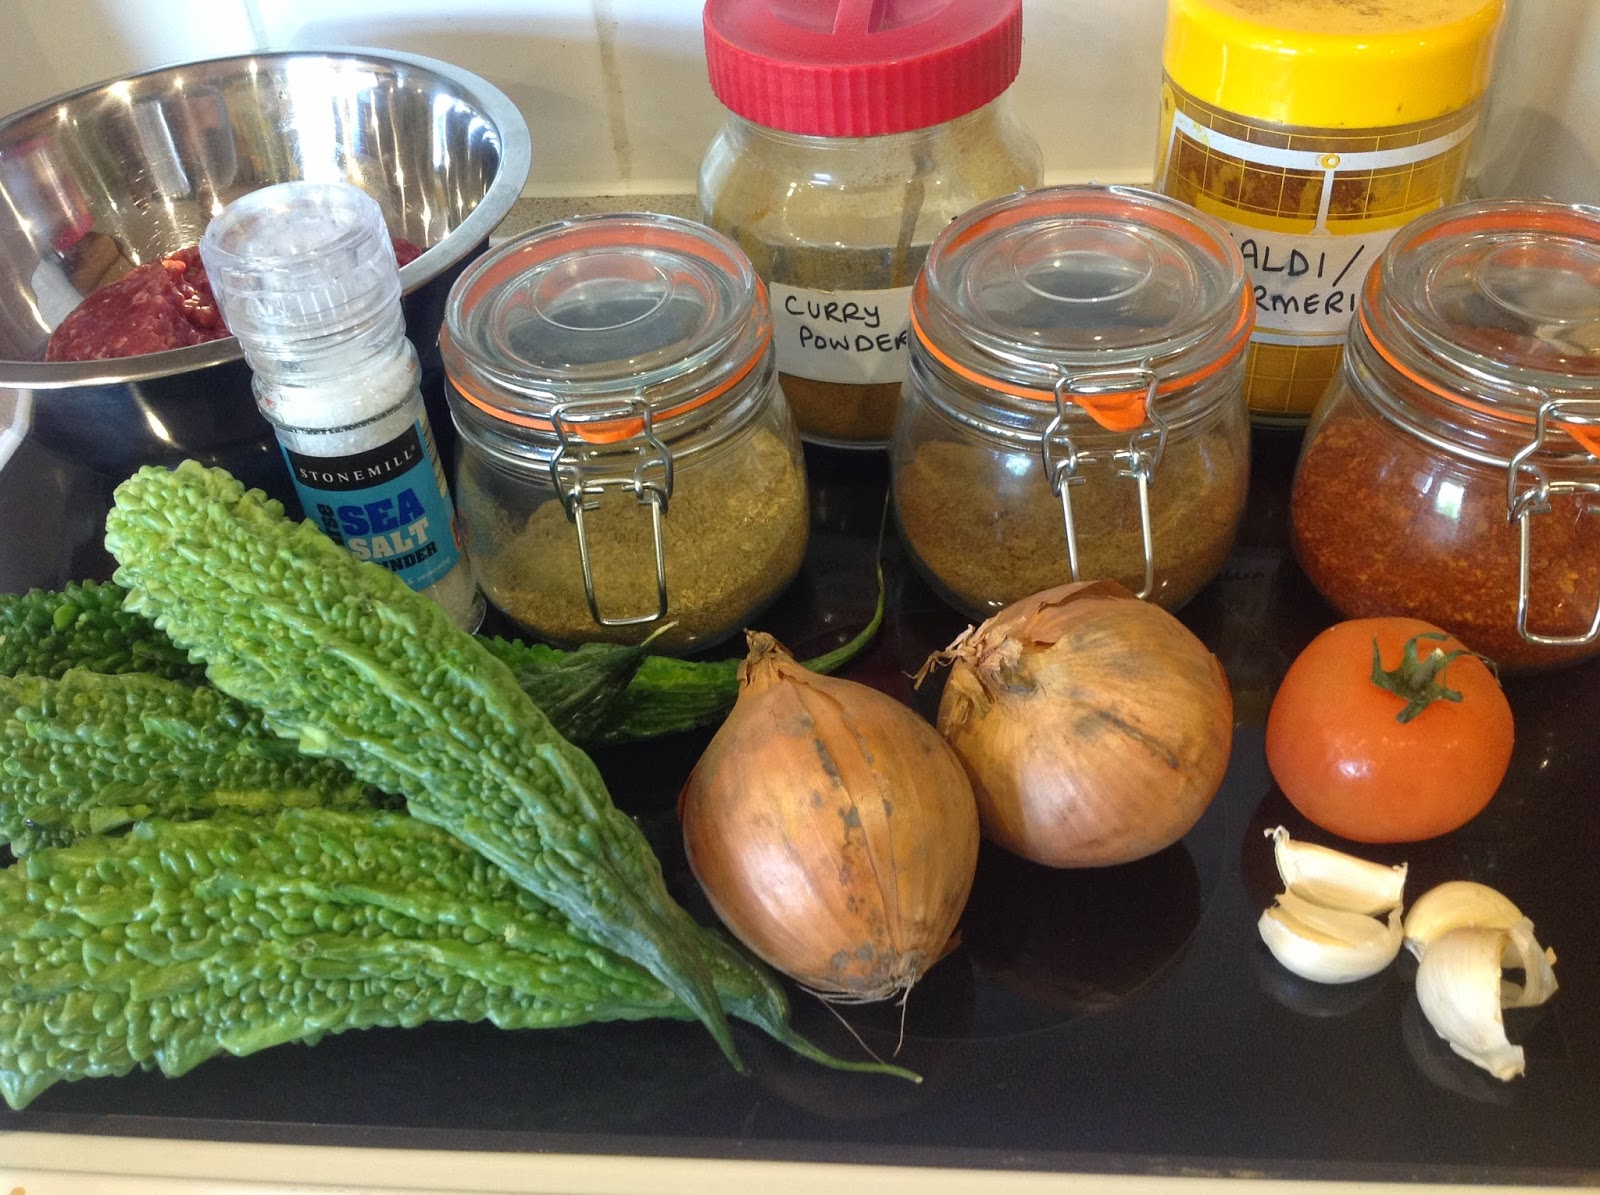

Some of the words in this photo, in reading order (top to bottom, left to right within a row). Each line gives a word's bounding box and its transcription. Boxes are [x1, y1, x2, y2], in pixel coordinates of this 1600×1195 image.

[1240, 238, 1365, 288] ALDI/
[784, 295, 881, 329] CURRY
[1253, 284, 1356, 315] RMERI
[799, 325, 908, 353] POWDER
[300, 450, 414, 483] STONEMILL
[336, 487, 426, 537] SEA
[347, 516, 430, 561] SALT
[378, 540, 439, 572] INDER
